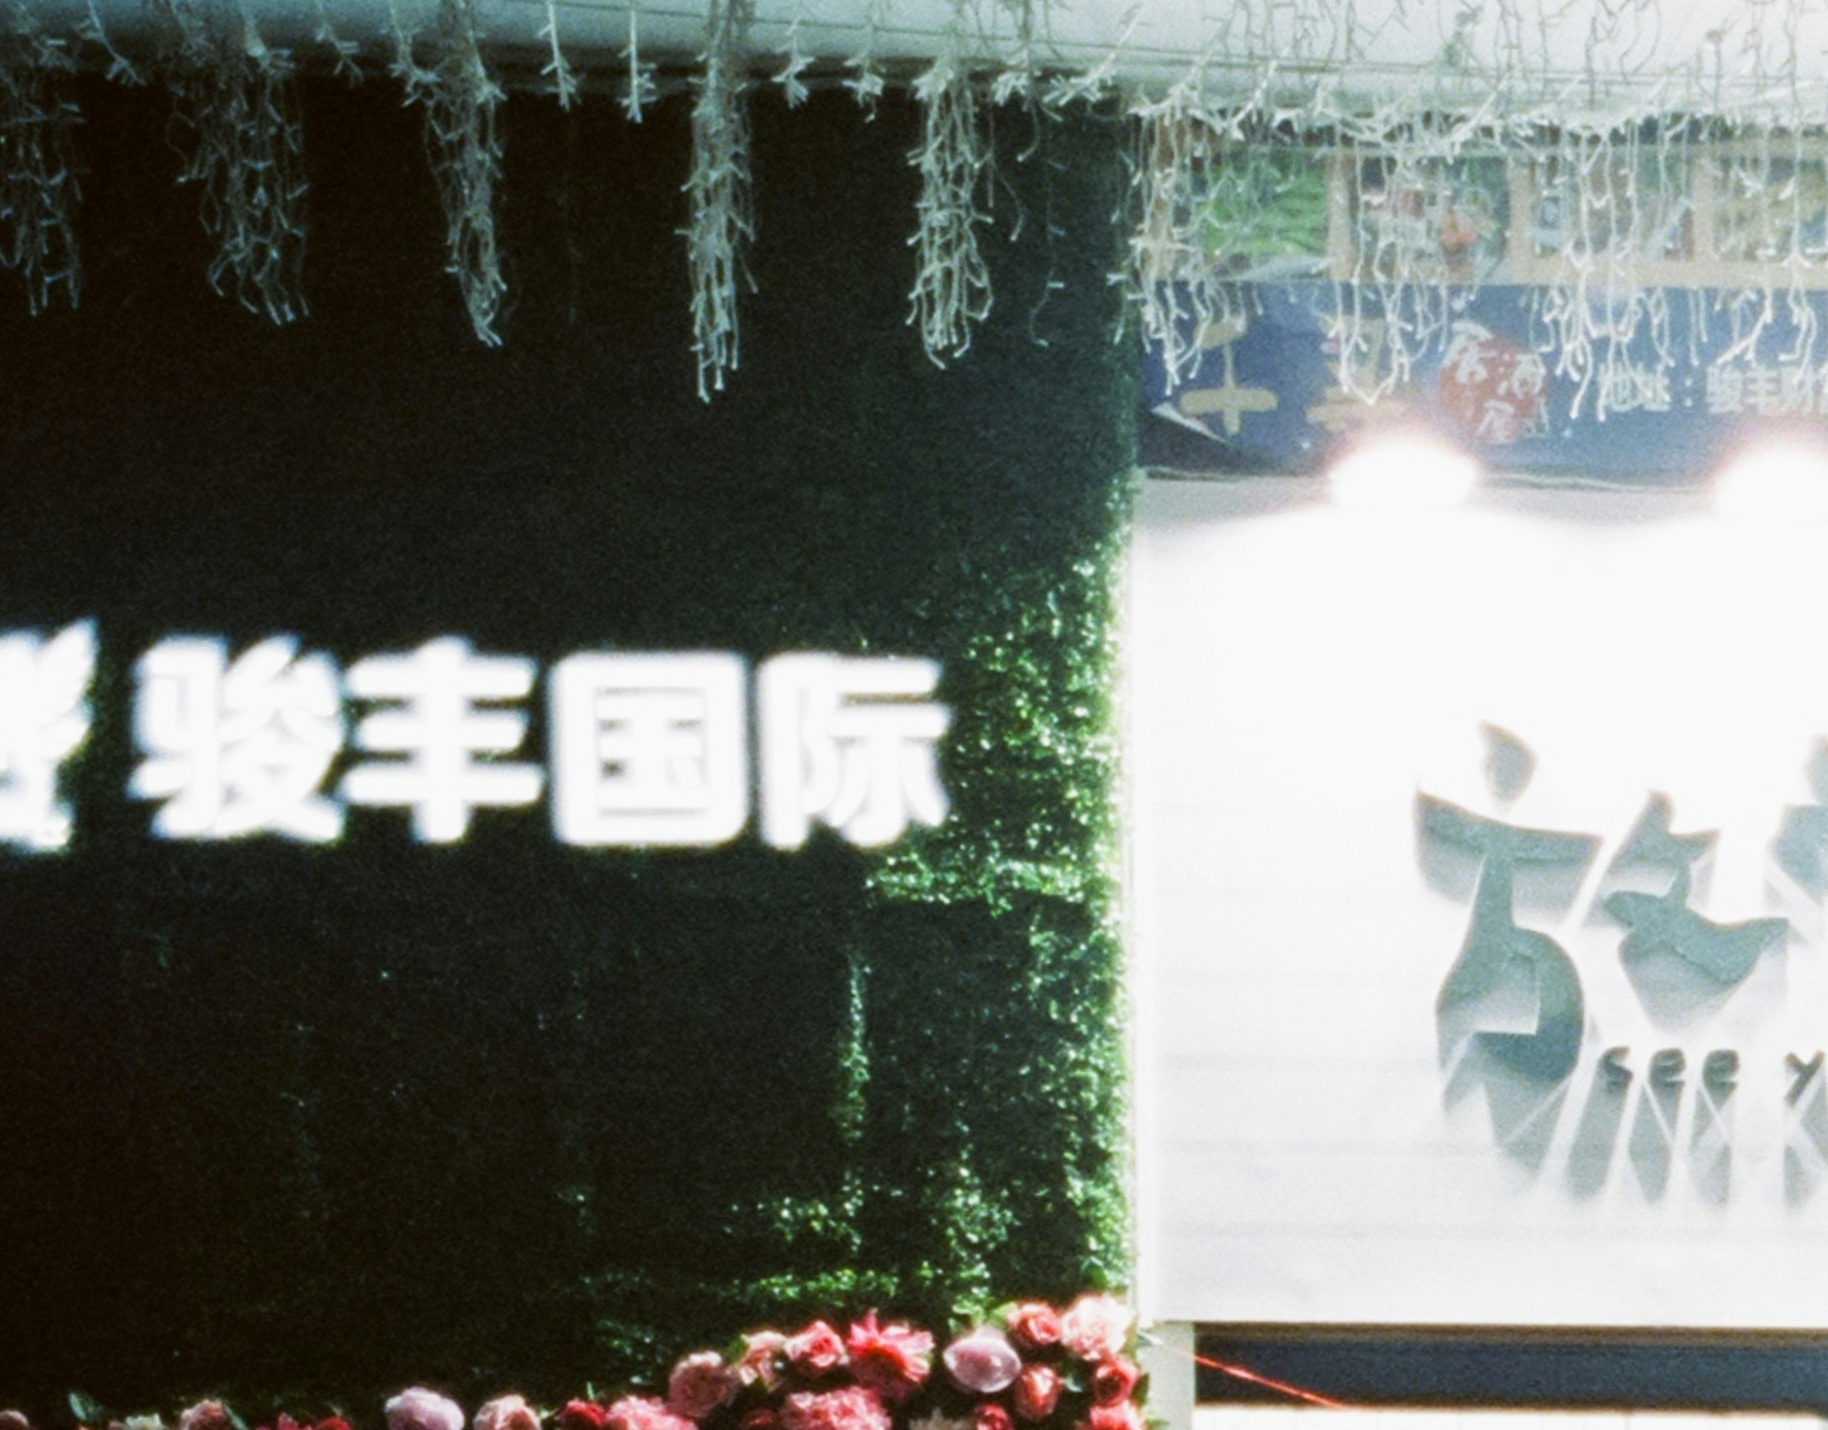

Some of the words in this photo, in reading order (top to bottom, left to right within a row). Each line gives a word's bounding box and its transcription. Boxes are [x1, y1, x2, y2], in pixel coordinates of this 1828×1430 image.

[123, 631, 952, 852] 骏丰国际
[1597, 1045, 1741, 1090] see
